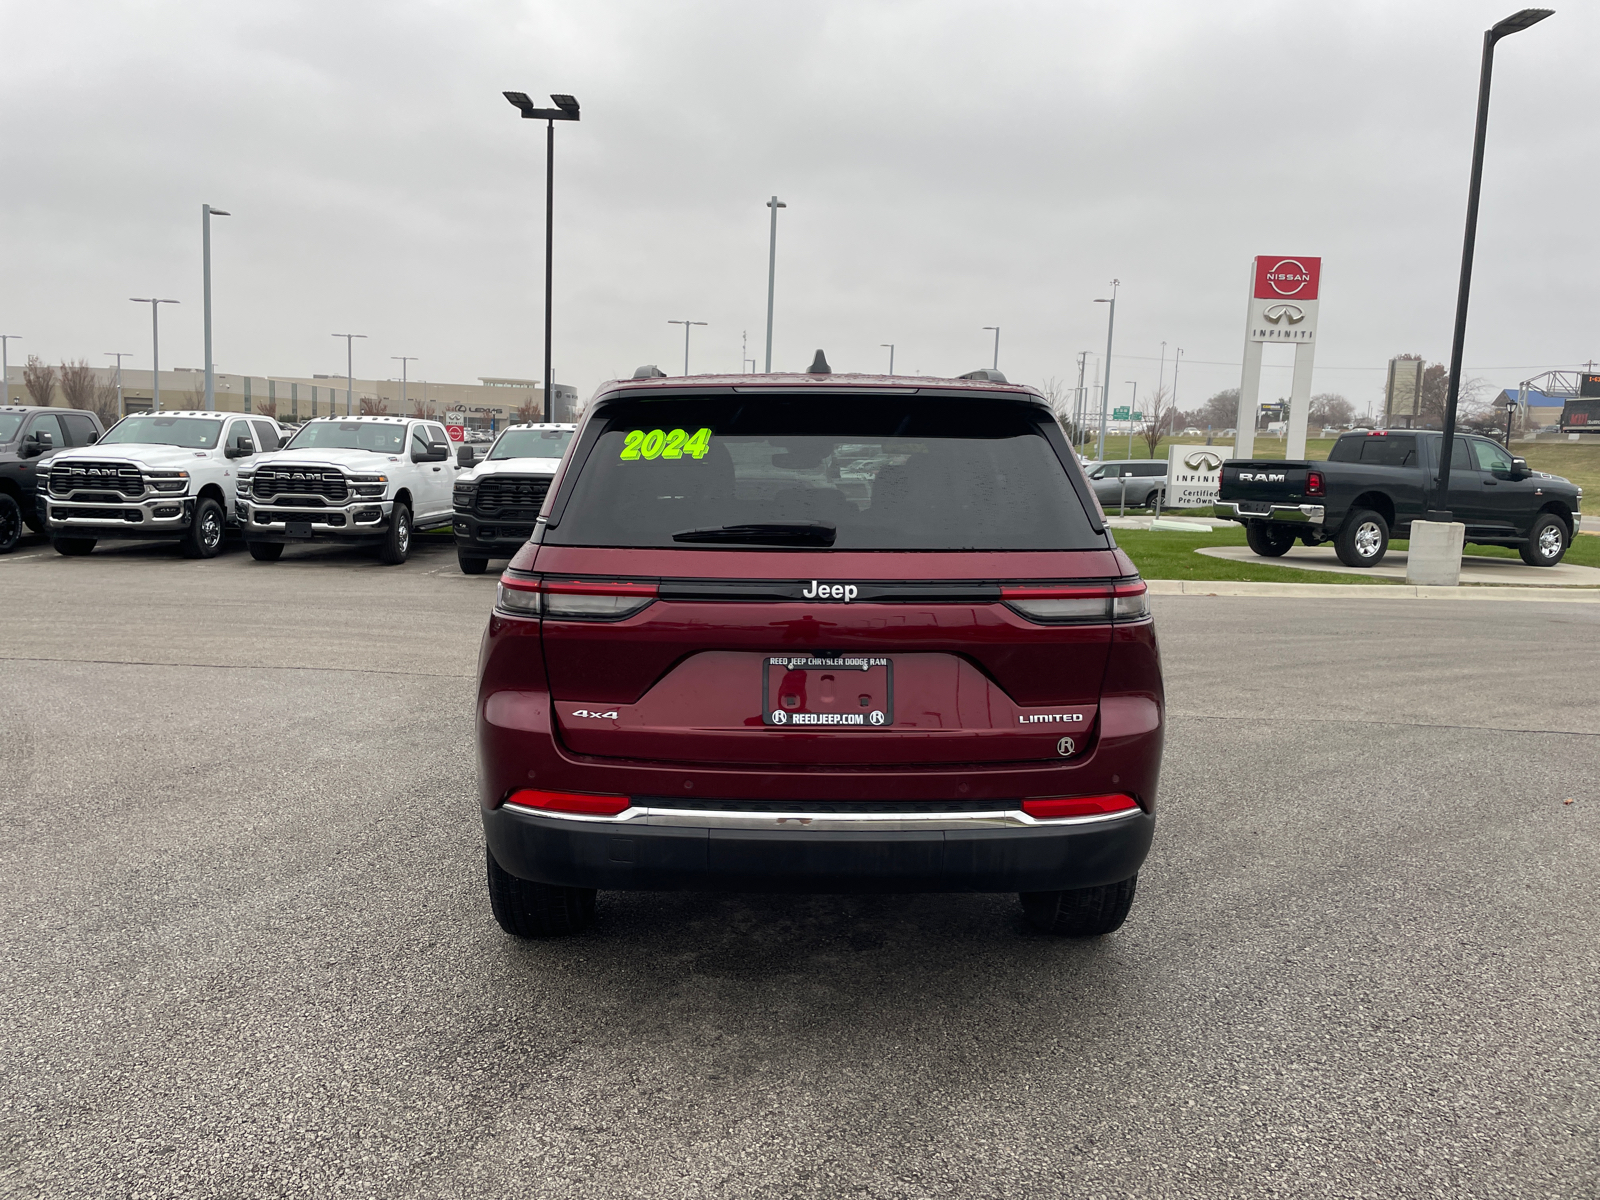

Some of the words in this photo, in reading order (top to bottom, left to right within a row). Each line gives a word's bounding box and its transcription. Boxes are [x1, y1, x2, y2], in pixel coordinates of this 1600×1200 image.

[1267, 273, 1310, 281] NISSAN
[1253, 329, 1313, 338] INFINITI
[620, 428, 712, 461] 2024
[71, 468, 117, 476] RAM
[276, 472, 322, 480] RAM
[1176, 475, 1220, 483] INFINI
[1239, 472, 1285, 482] RAM
[1183, 489, 1219, 497] Certified
[802, 580, 858, 602] Jeep
[769, 657, 788, 665] REED
[790, 657, 807, 665] JEEP
[808, 657, 843, 665] CHRYSLER
[845, 658, 868, 666] DODGE
[870, 658, 887, 666] RAM
[572, 709, 619, 720] 4x4
[792, 714, 864, 724] REEDJEEP.COM
[1019, 713, 1083, 724] LIMITED
